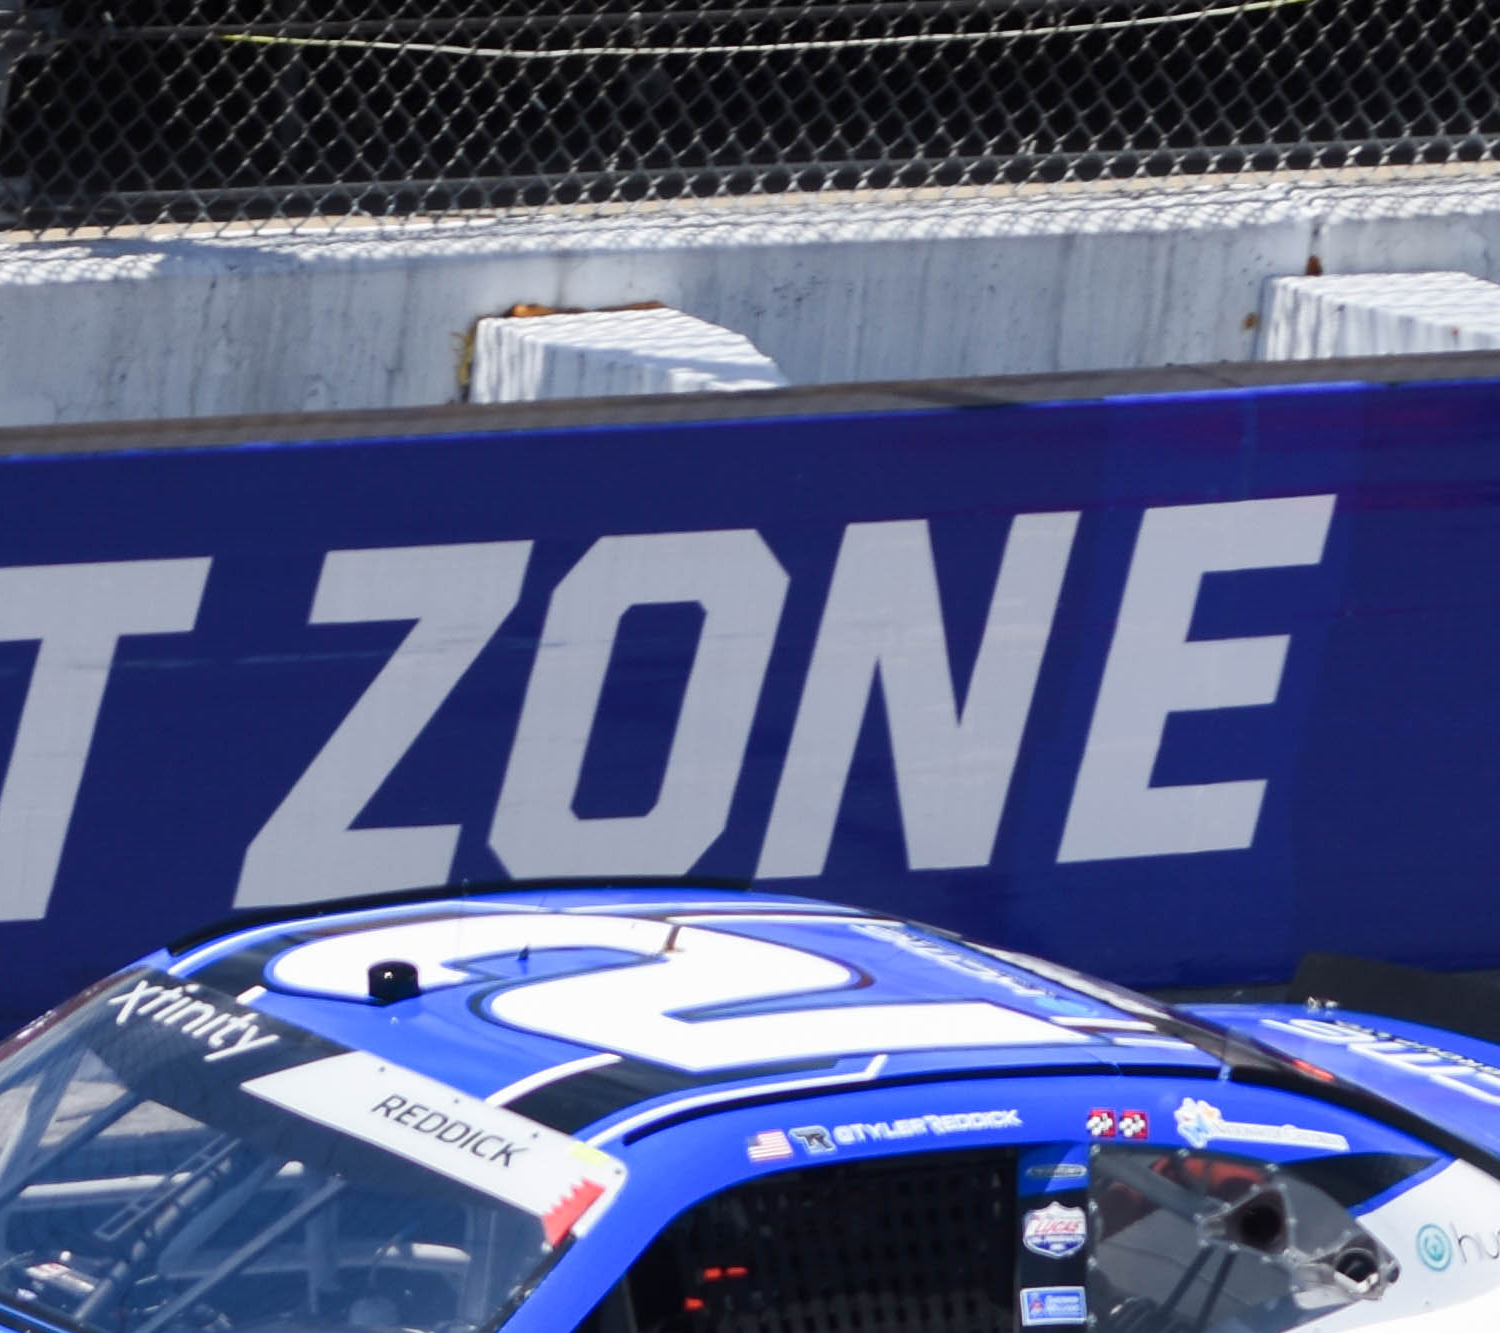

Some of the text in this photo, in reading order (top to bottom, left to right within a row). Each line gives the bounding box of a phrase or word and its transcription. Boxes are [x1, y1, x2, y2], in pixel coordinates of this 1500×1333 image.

[233, 493, 1337, 909] ZONE
[108, 975, 280, 1064] xfinity
[266, 914, 1100, 1072] 2
[371, 1093, 530, 1170] REDDICK
